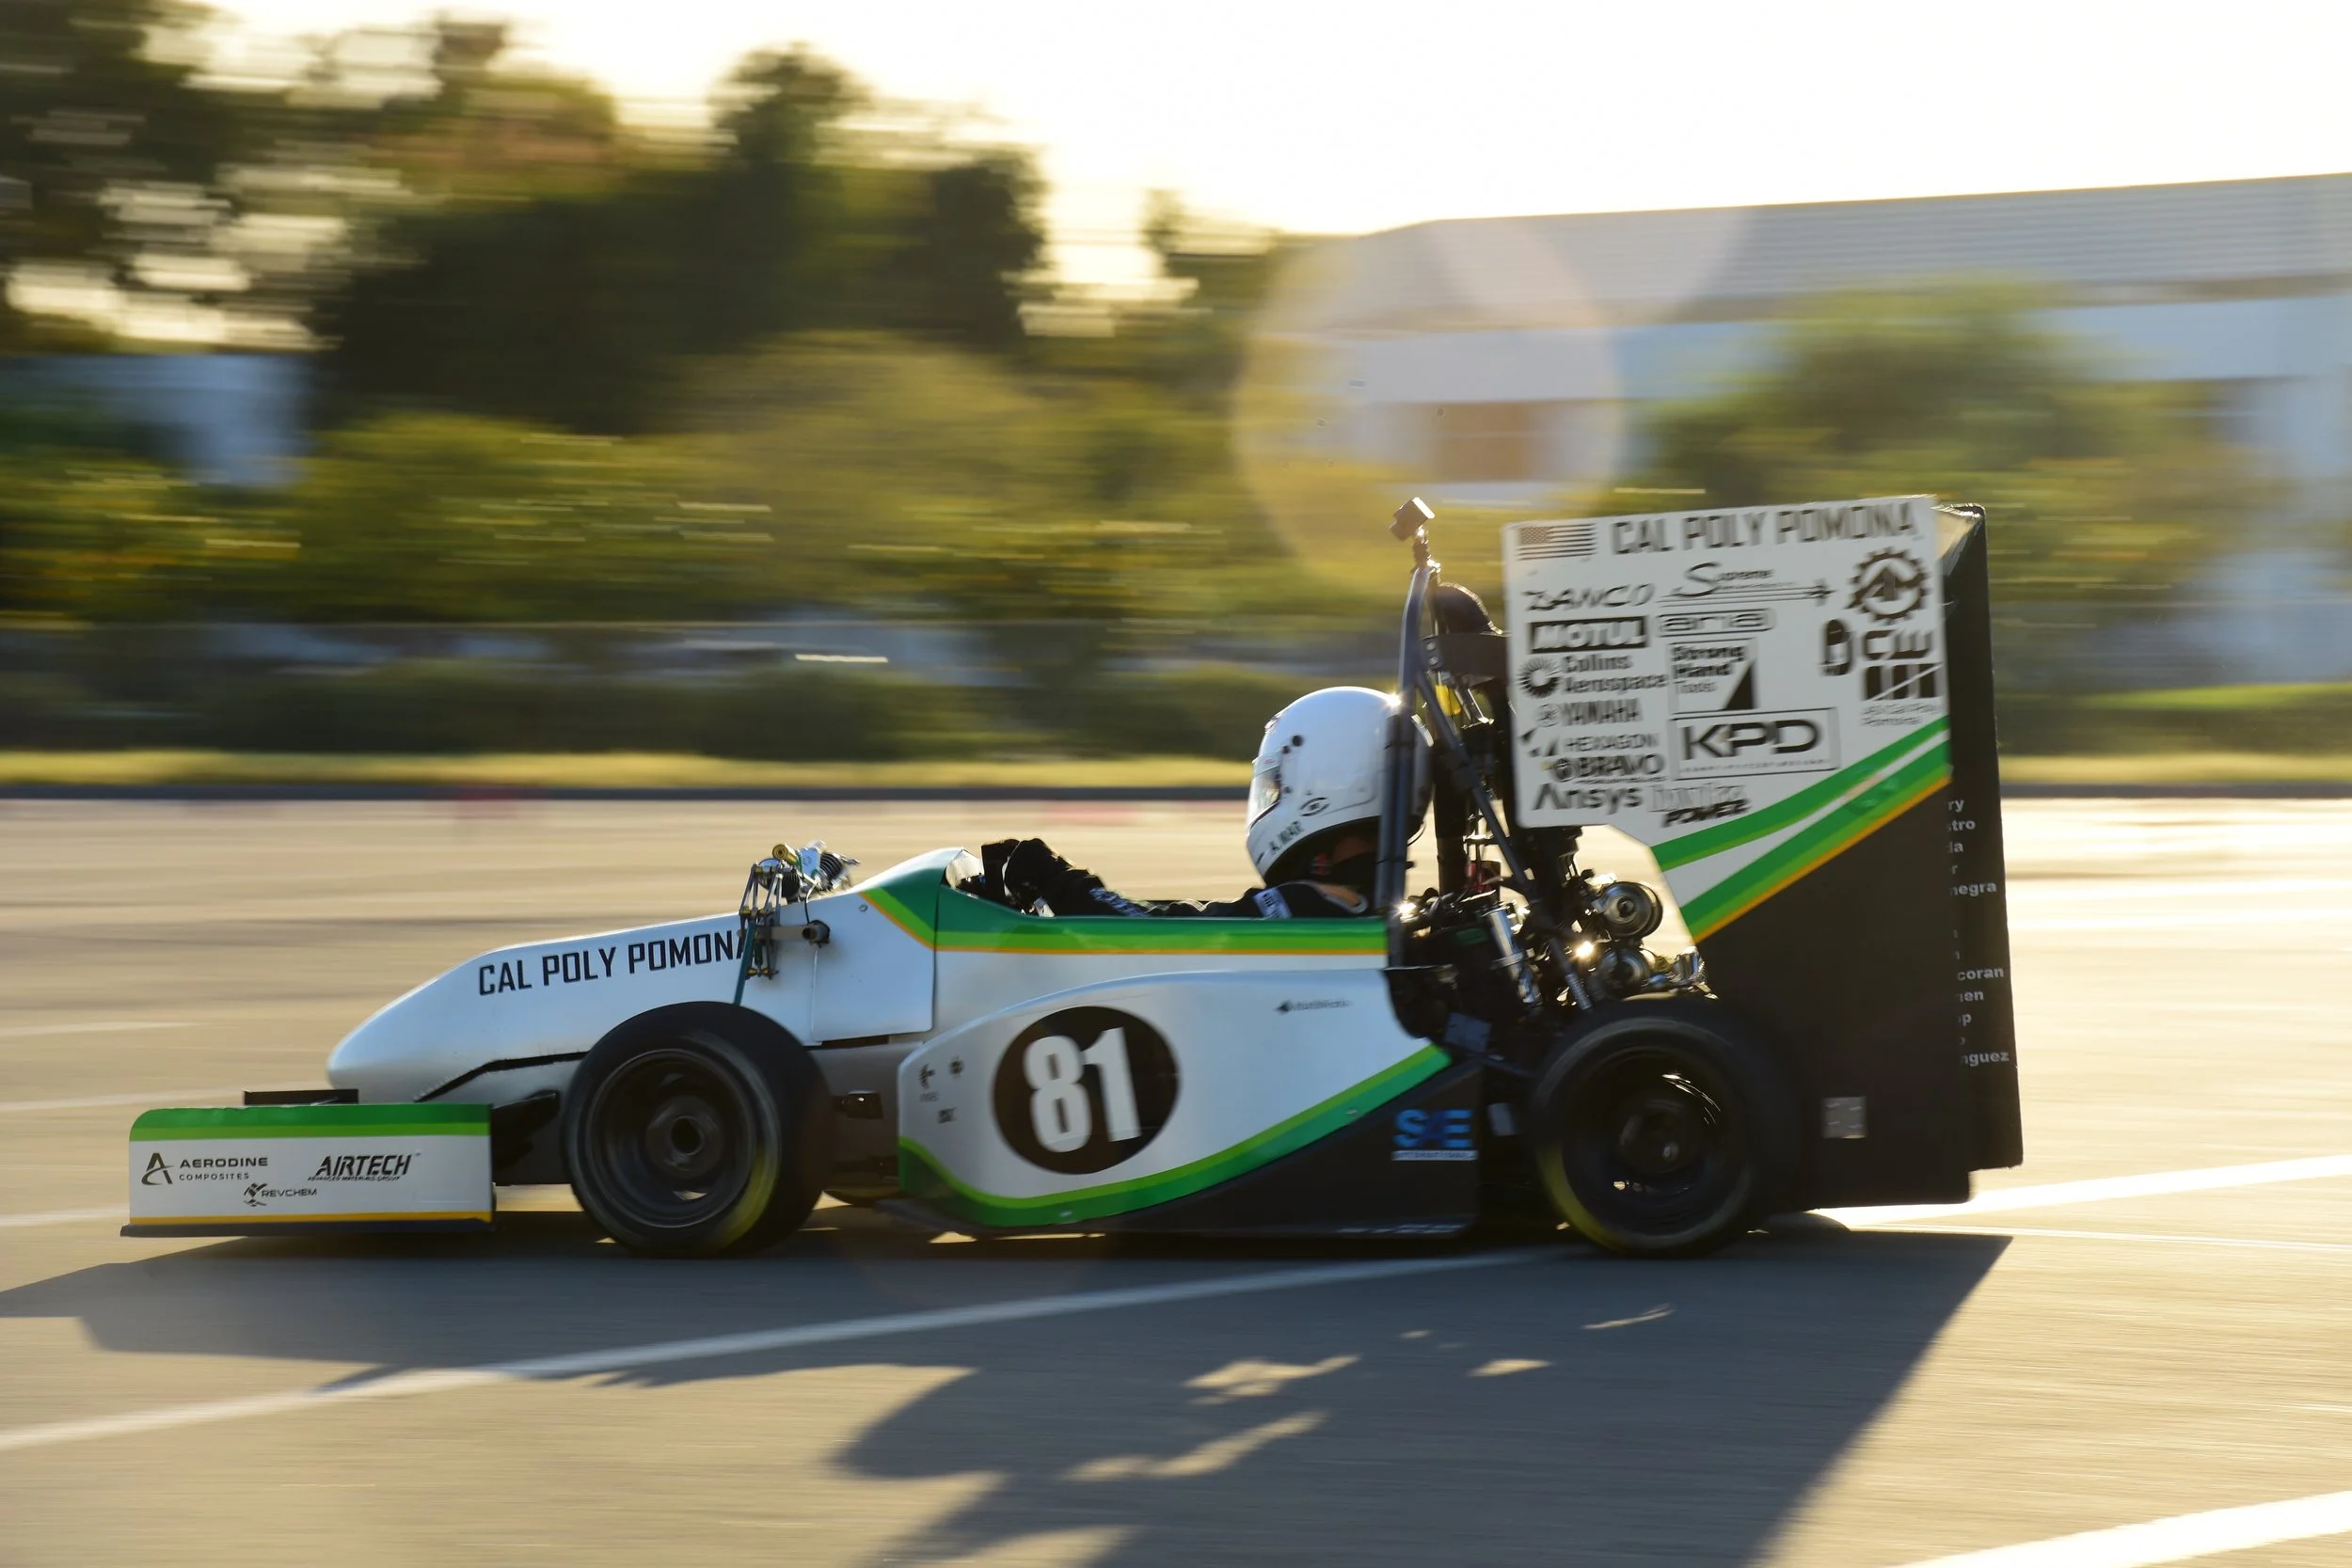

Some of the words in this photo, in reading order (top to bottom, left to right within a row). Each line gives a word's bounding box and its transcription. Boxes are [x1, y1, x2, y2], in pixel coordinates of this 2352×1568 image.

[1612, 519, 1672, 554] CAL
[1683, 512, 1767, 550] POLY
[1775, 502, 1918, 544] POMONA
[1533, 619, 1646, 649] MOTUL
[1563, 655, 1633, 673] Collins
[1563, 674, 1668, 693] Aerospace
[1562, 698, 1643, 725] YAMAHA
[1565, 734, 1660, 752] HEXAGON
[1681, 719, 1822, 760] KPD
[1578, 753, 1665, 777] BRAVO
[1533, 783, 1644, 815] Ansys
[479, 960, 532, 996] CAL
[542, 946, 616, 987] POLY
[1025, 1026, 1141, 1153] 81
[180, 1157, 268, 1168] AERODINE
[315, 1154, 412, 1176] AIRTECH
[179, 1173, 249, 1181] COMPOSITES
[262, 1189, 318, 1197] REVCHEM
